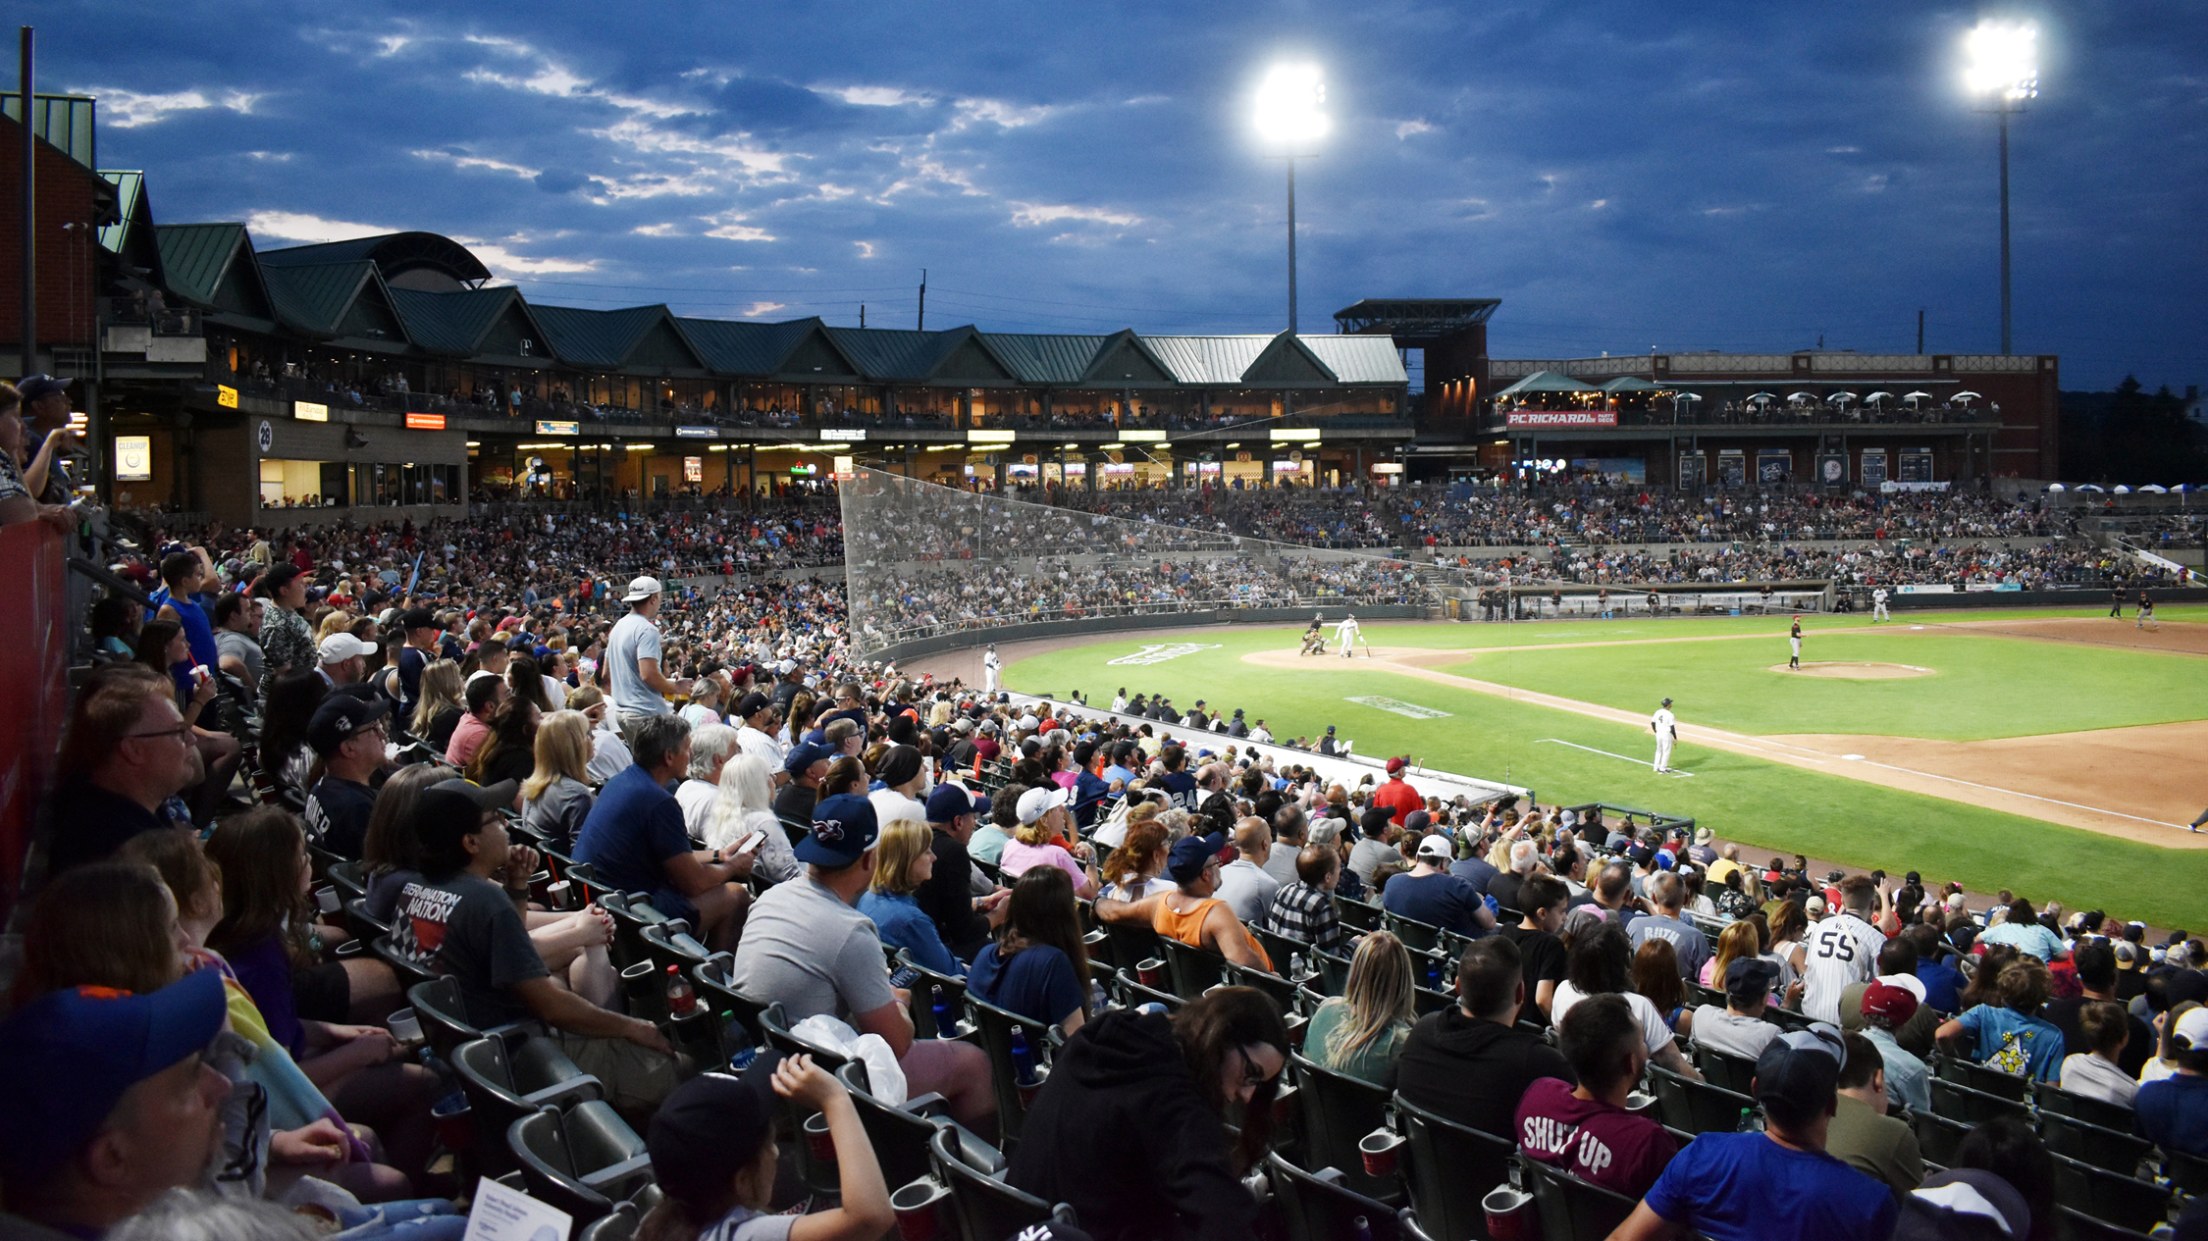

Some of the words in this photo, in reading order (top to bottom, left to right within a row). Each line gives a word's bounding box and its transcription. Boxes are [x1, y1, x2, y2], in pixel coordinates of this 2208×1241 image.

[260, 426, 271, 445] 28
[1172, 789, 1198, 811] 24
[406, 897, 454, 923] NATION
[1644, 926, 1680, 946] RUTH
[1523, 1116, 1579, 1155] SHUT
[1578, 1130, 1612, 1175] UP
